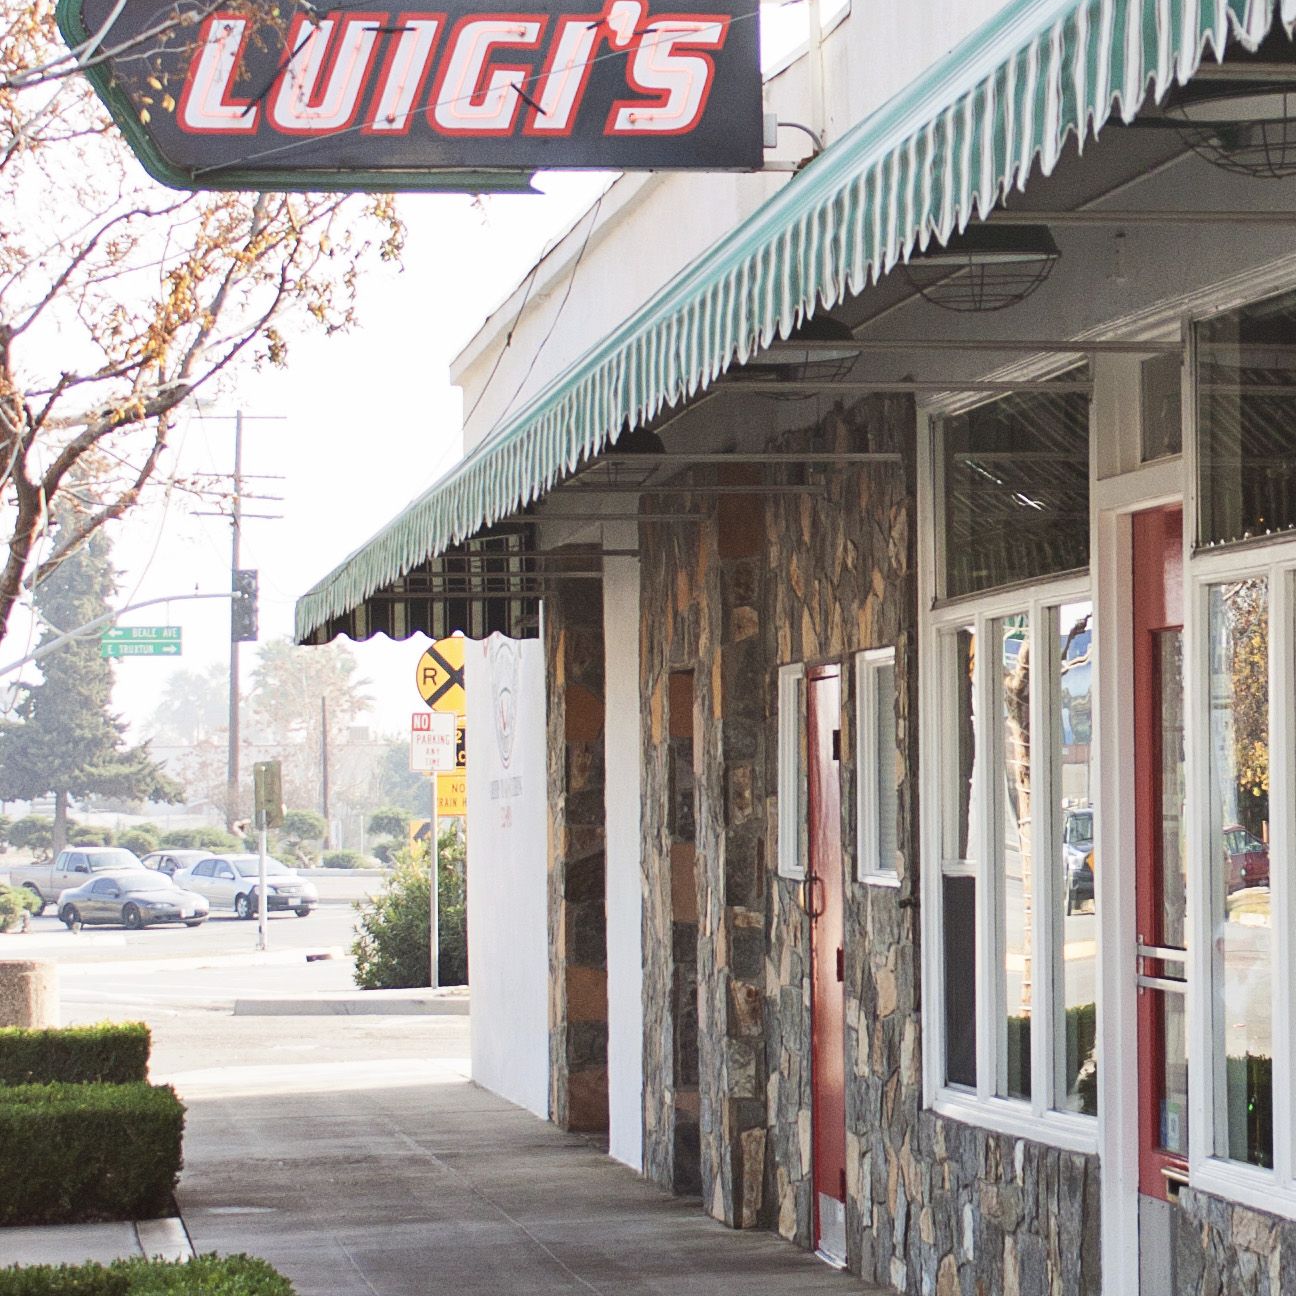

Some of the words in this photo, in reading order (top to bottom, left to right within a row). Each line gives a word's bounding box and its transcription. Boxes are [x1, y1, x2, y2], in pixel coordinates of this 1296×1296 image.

[132, 627, 158, 638] BEALE
[162, 627, 178, 638] AVE
[423, 667, 437, 685] R
[412, 714, 430, 730] NO
[416, 734, 450, 745] PARKING
[425, 747, 440, 756] ANY
[425, 757, 440, 766] TIME
[451, 783, 466, 793] NO
[436, 797, 457, 808] RAIN
